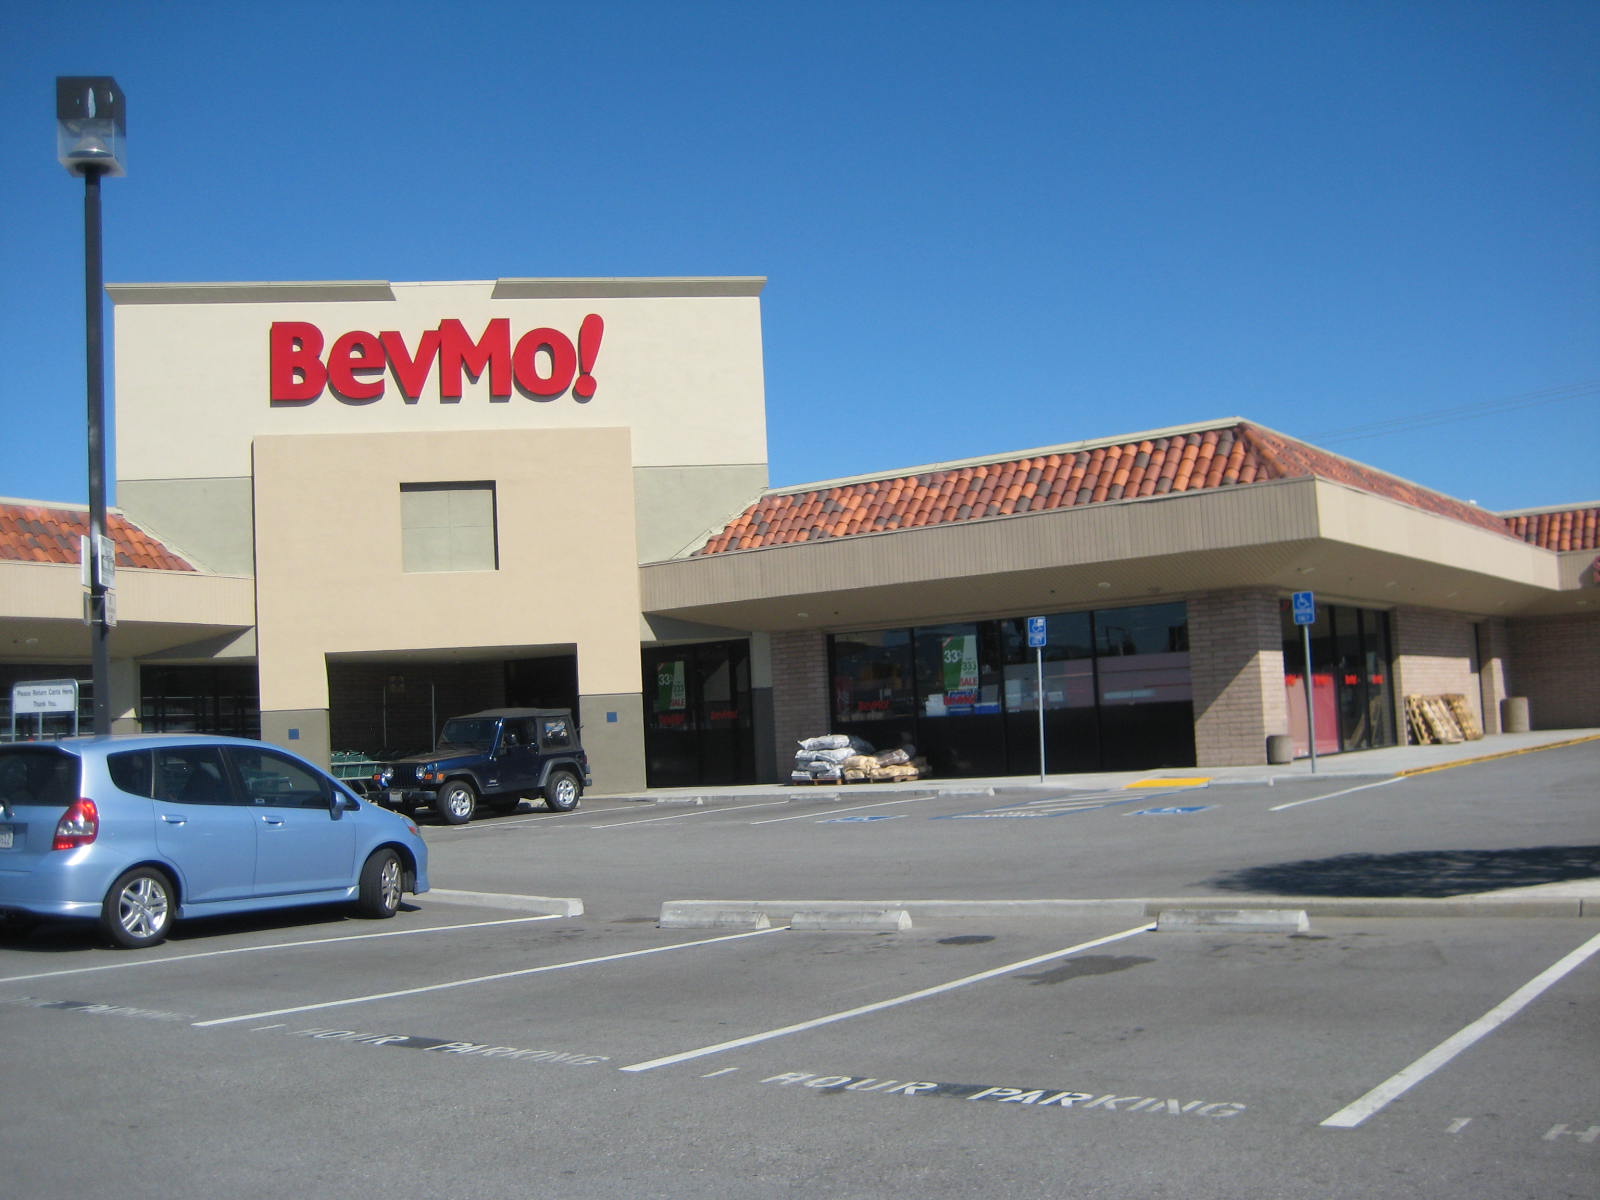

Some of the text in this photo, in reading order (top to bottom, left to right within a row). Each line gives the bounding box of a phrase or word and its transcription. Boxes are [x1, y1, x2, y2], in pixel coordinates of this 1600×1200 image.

[270, 313, 604, 406] BevMo!
[758, 1071, 939, 1096] HOUR
[966, 1086, 1247, 1117] PARKING
